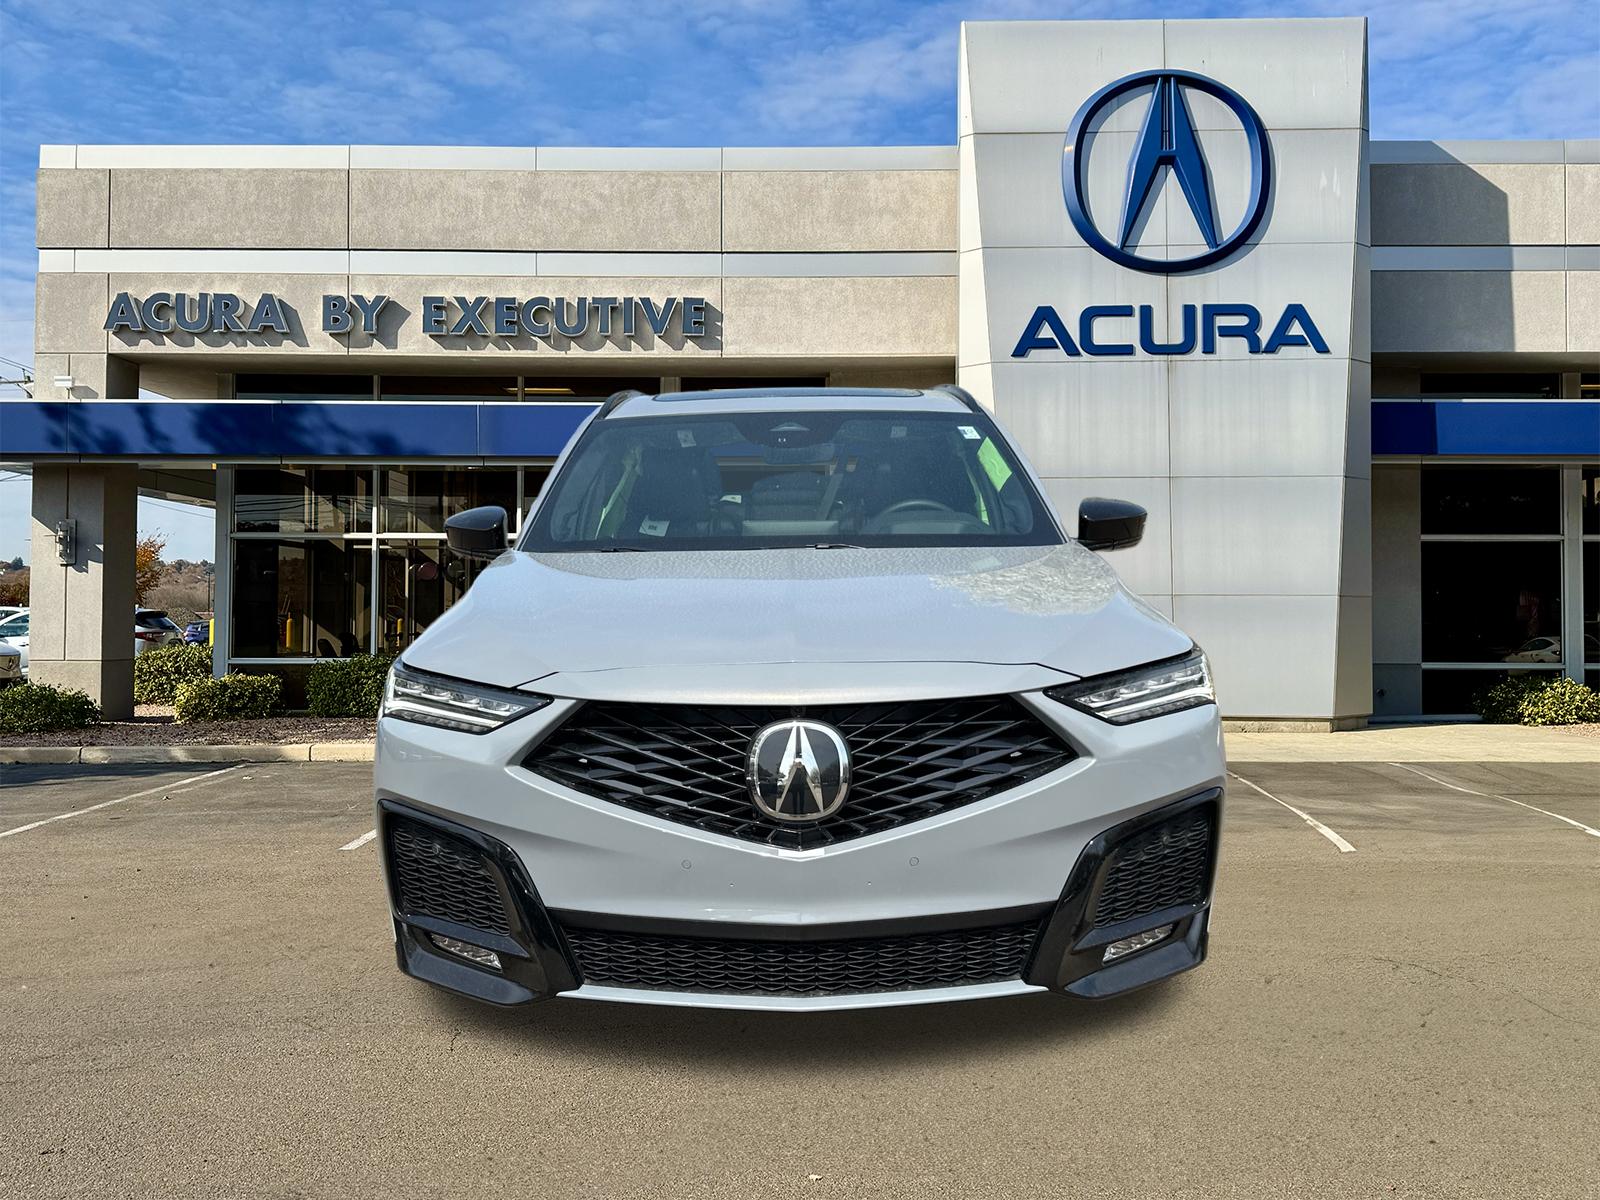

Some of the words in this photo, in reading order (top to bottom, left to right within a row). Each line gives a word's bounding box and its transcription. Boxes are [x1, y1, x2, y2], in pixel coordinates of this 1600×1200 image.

[104, 292, 289, 334] ACURA
[322, 294, 390, 336] BY
[421, 295, 706, 338] EXECUTIVE
[1011, 303, 1331, 358] ACURA
